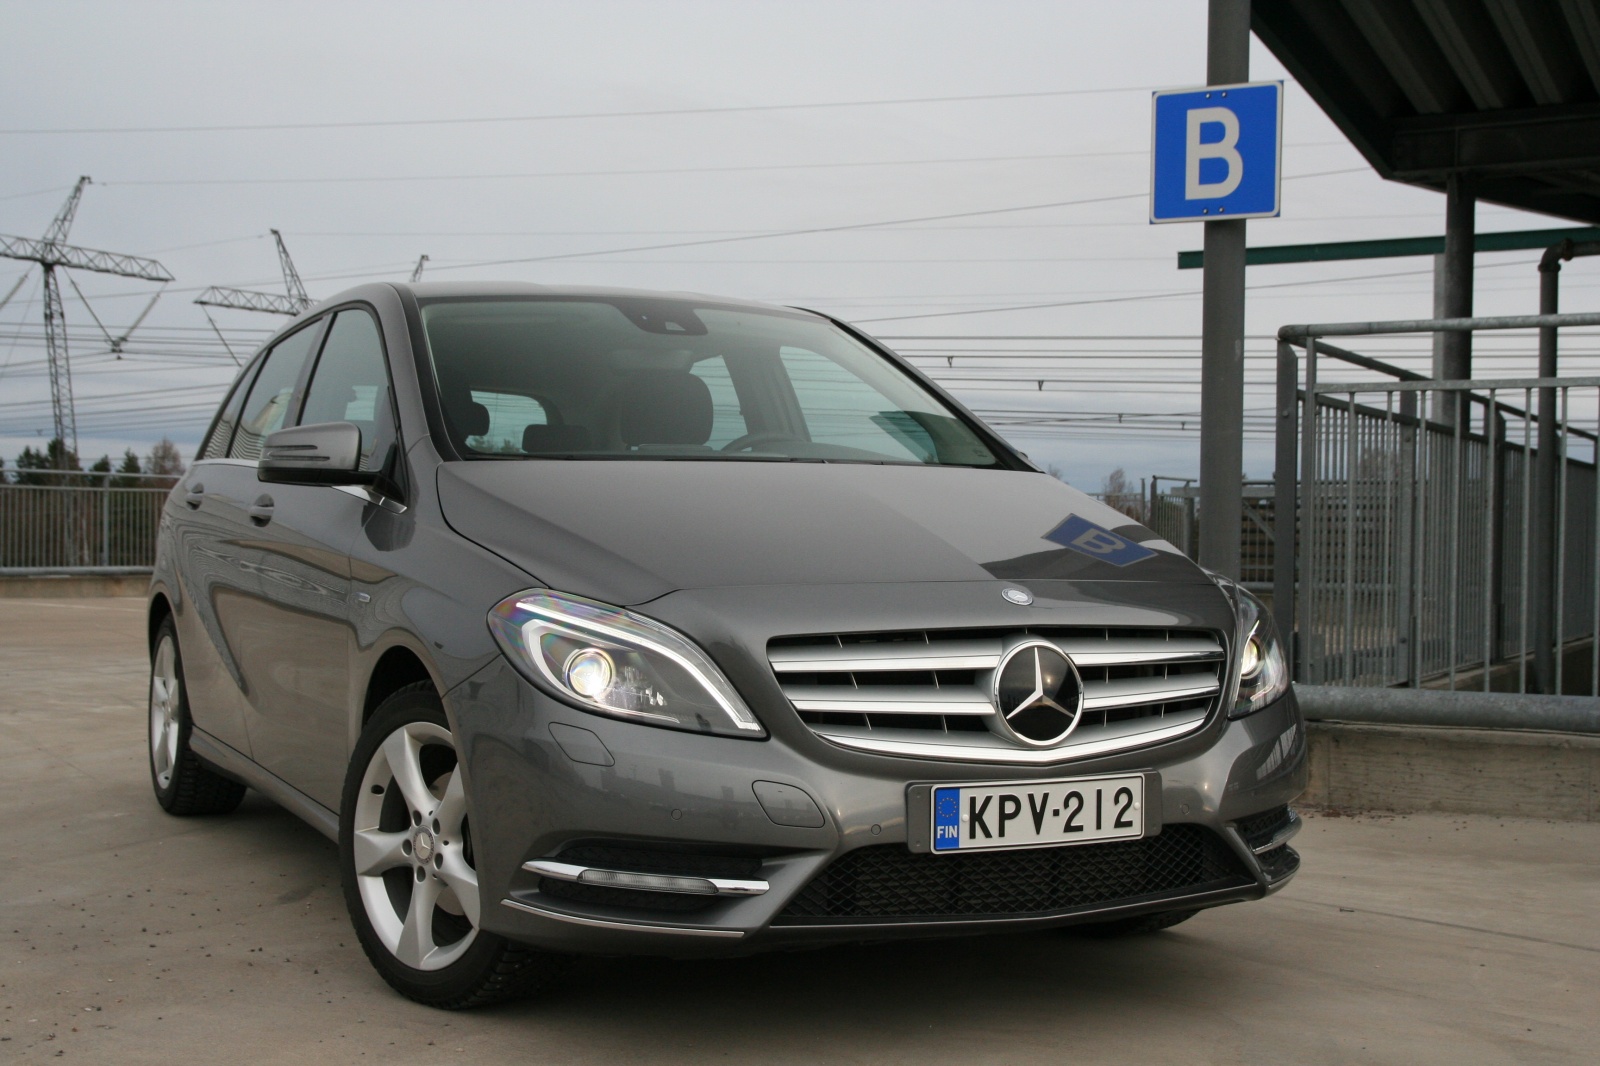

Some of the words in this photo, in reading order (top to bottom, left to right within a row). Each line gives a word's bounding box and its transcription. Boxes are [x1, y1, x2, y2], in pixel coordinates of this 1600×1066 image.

[1185, 107, 1243, 200] B
[936, 825, 958, 839] FIN
[969, 786, 1134, 840] KPV-212
